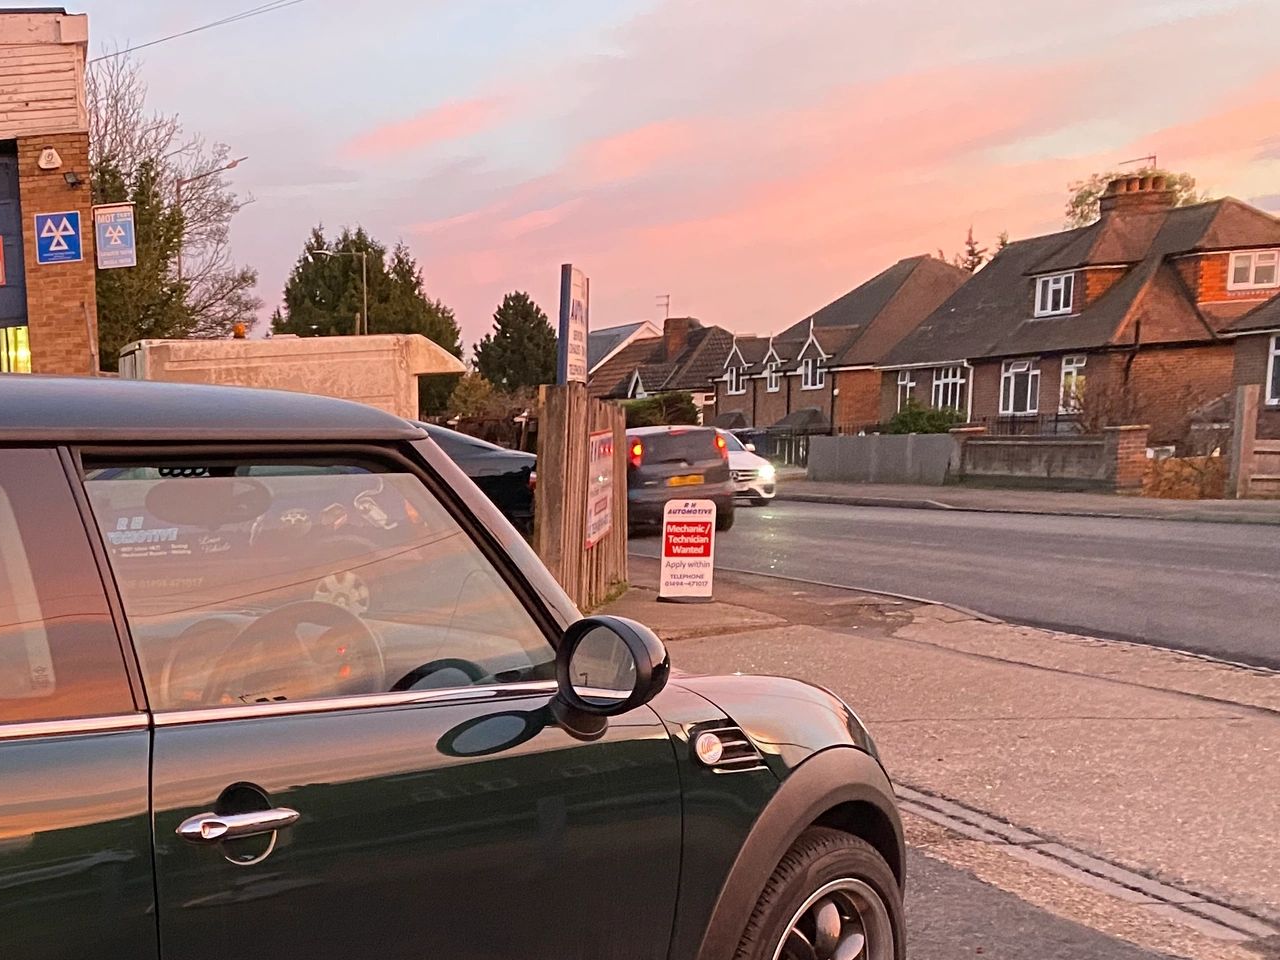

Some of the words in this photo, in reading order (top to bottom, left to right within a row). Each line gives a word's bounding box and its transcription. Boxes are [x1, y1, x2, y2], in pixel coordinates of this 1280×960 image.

[97, 214, 115, 223] MOT
[668, 535, 709, 543] Technician
[672, 546, 704, 554] Wanted
[665, 561, 686, 569] Apply
